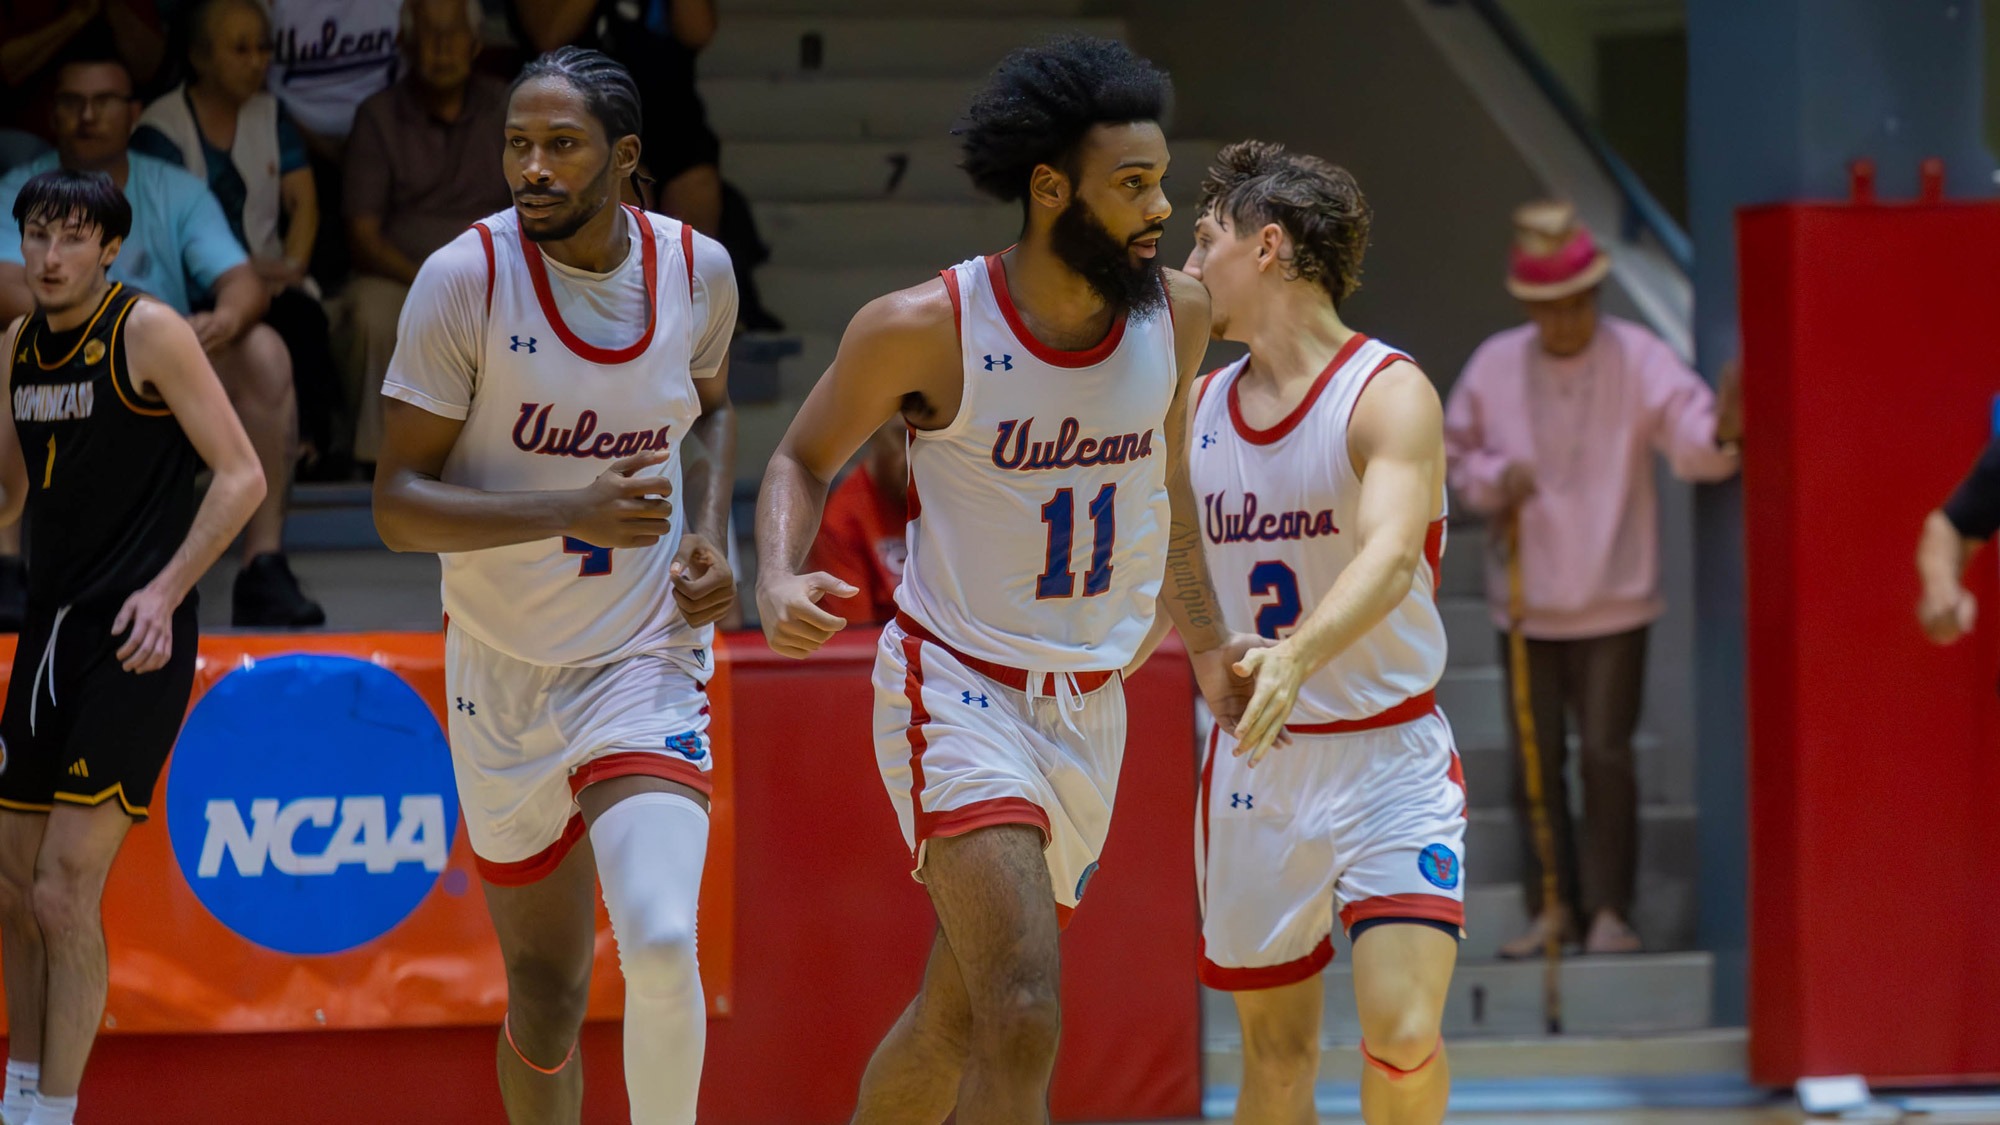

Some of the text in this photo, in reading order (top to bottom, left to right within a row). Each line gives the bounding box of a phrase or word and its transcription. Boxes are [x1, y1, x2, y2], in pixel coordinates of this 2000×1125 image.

[275, 17, 396, 63] Vulcan
[512, 402, 671, 460] Vulcans
[992, 416, 1154, 471] Vulcans
[42, 433, 56, 489] 1
[1036, 482, 1117, 600] 11
[1205, 490, 1340, 544] Vulcans
[1248, 559, 1303, 641] 2
[197, 794, 448, 878] NCAA
